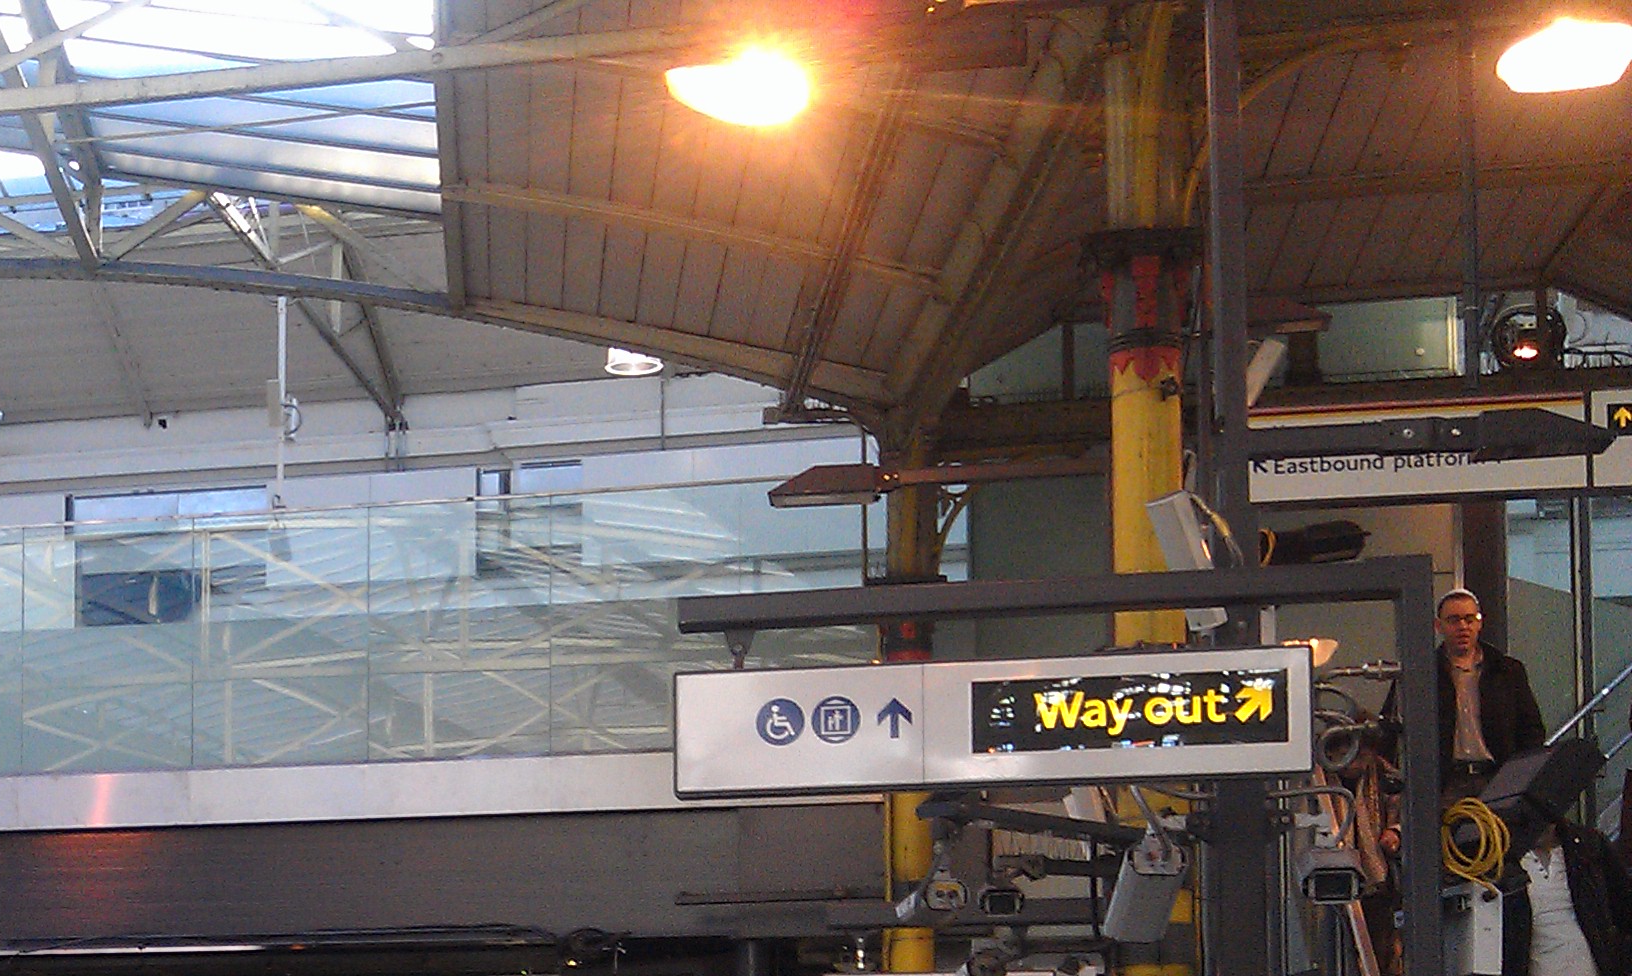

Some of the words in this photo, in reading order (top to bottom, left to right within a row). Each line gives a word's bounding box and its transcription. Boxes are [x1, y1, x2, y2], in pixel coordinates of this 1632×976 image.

[1274, 454, 1384, 475] Eastbound
[1033, 691, 1133, 736] Way
[1144, 689, 1227, 725] out
